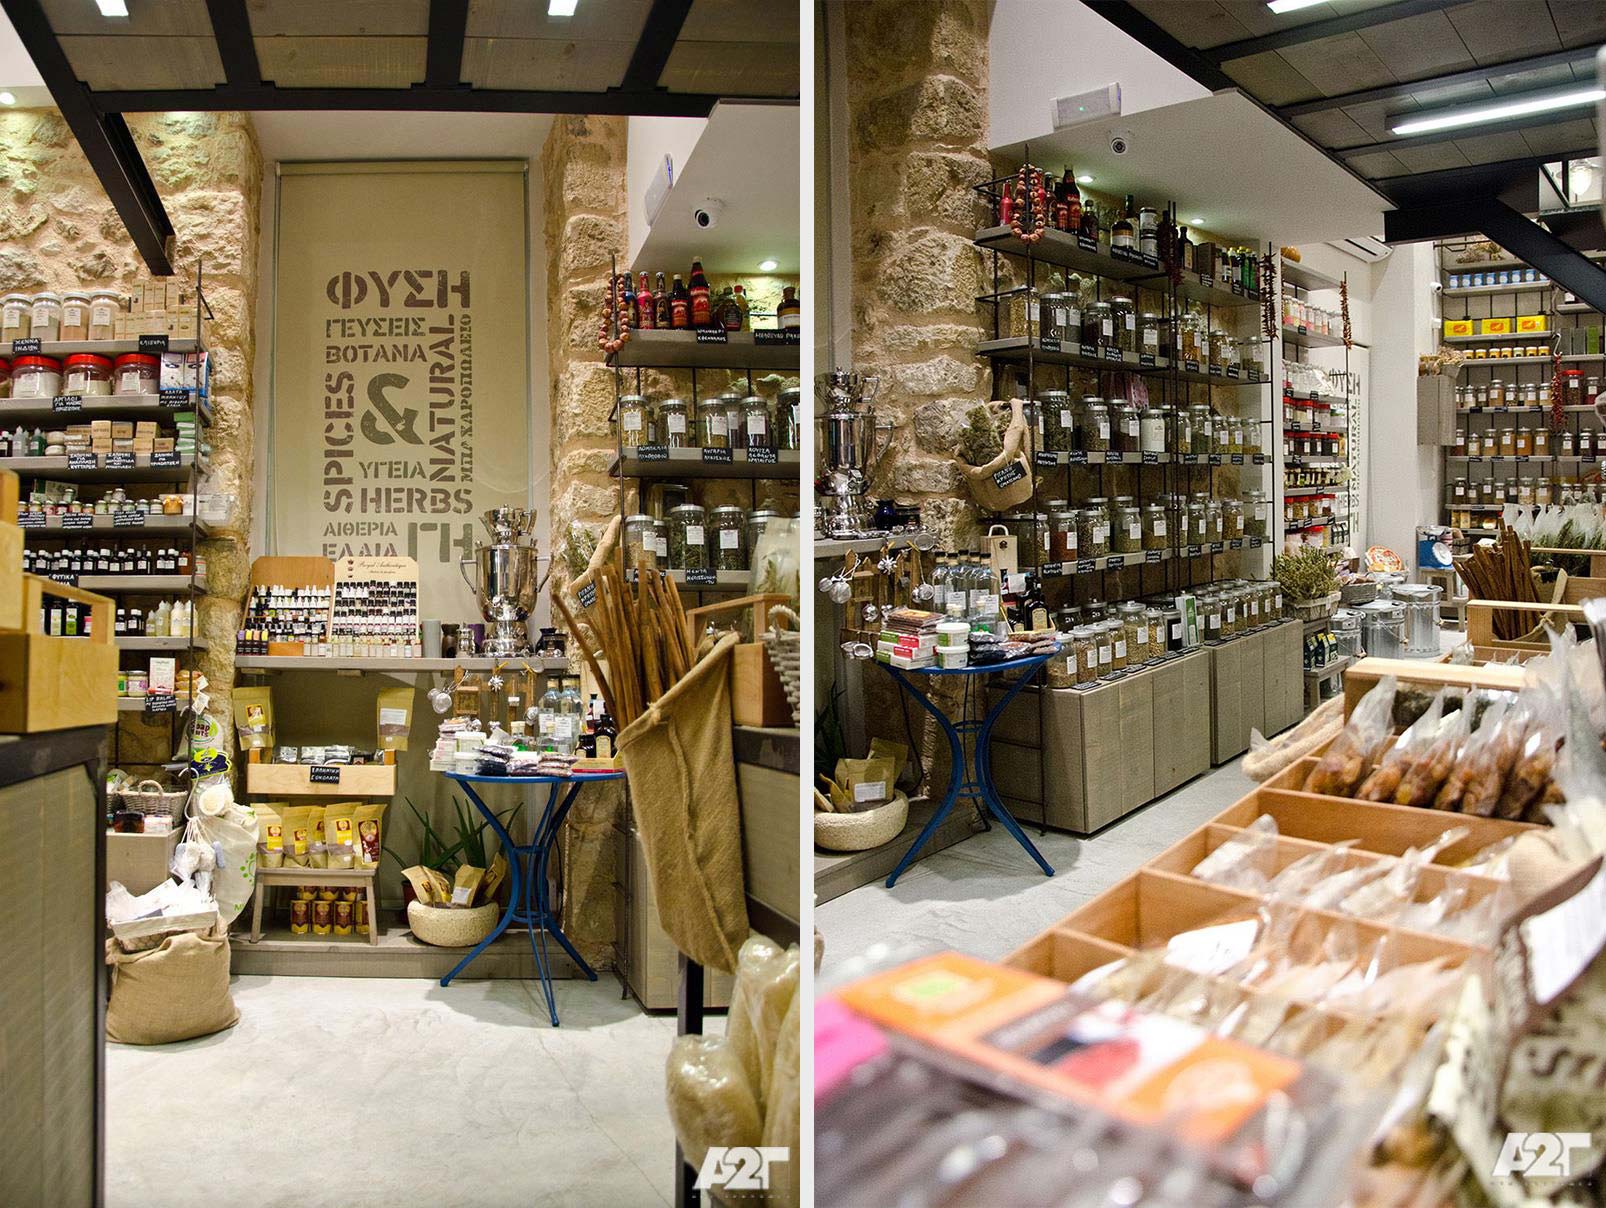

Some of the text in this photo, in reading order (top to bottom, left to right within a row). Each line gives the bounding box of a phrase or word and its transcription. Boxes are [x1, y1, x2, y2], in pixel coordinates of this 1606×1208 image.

[326, 270, 471, 309] ΦΥΣΗ
[325, 317, 427, 339] ΓΕΥΣΕΙΣ
[325, 343, 428, 364] ΒΟΤΑΝΑ
[429, 313, 456, 482] NATURAL
[323, 370, 355, 515] SPICES
[359, 460, 427, 479] ΥΓΕΙΑ
[360, 487, 474, 514] HERBS
[323, 521, 399, 537] ΑΙΘΕΡΙΑ
